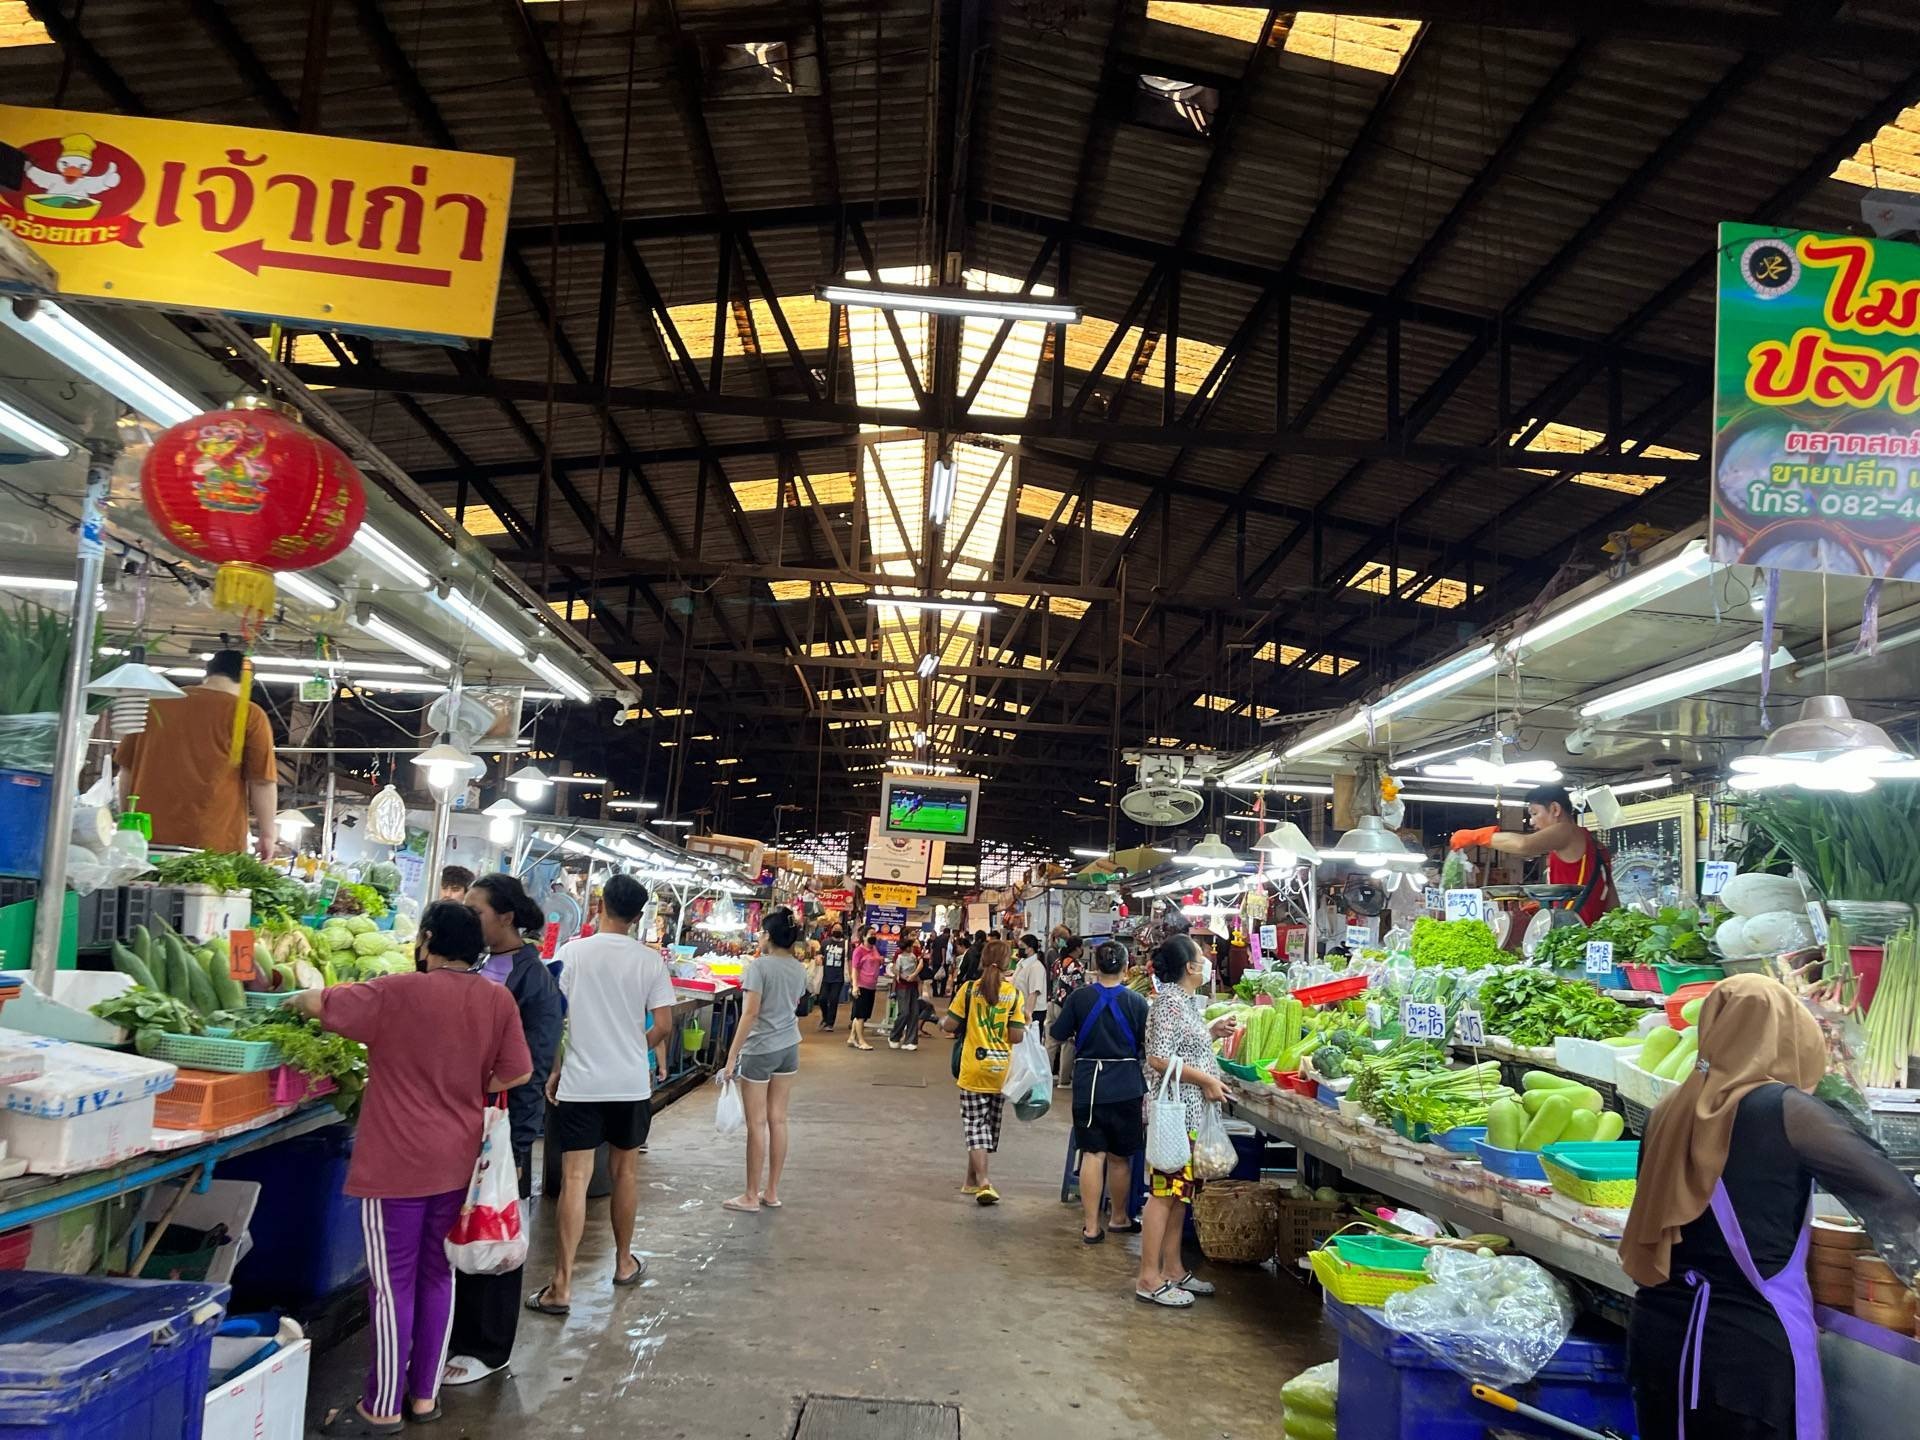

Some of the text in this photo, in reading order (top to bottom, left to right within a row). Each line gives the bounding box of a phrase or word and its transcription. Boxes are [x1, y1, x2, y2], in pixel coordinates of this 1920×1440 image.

[154, 148, 488, 262] เจ้าเก่า
[1750, 331, 1920, 411] ปลา
[1751, 484, 1920, 518] โทร. 082-4
[1458, 900, 1477, 917] 30
[233, 945, 253, 973] 15
[1408, 1017, 1417, 1034] 2
